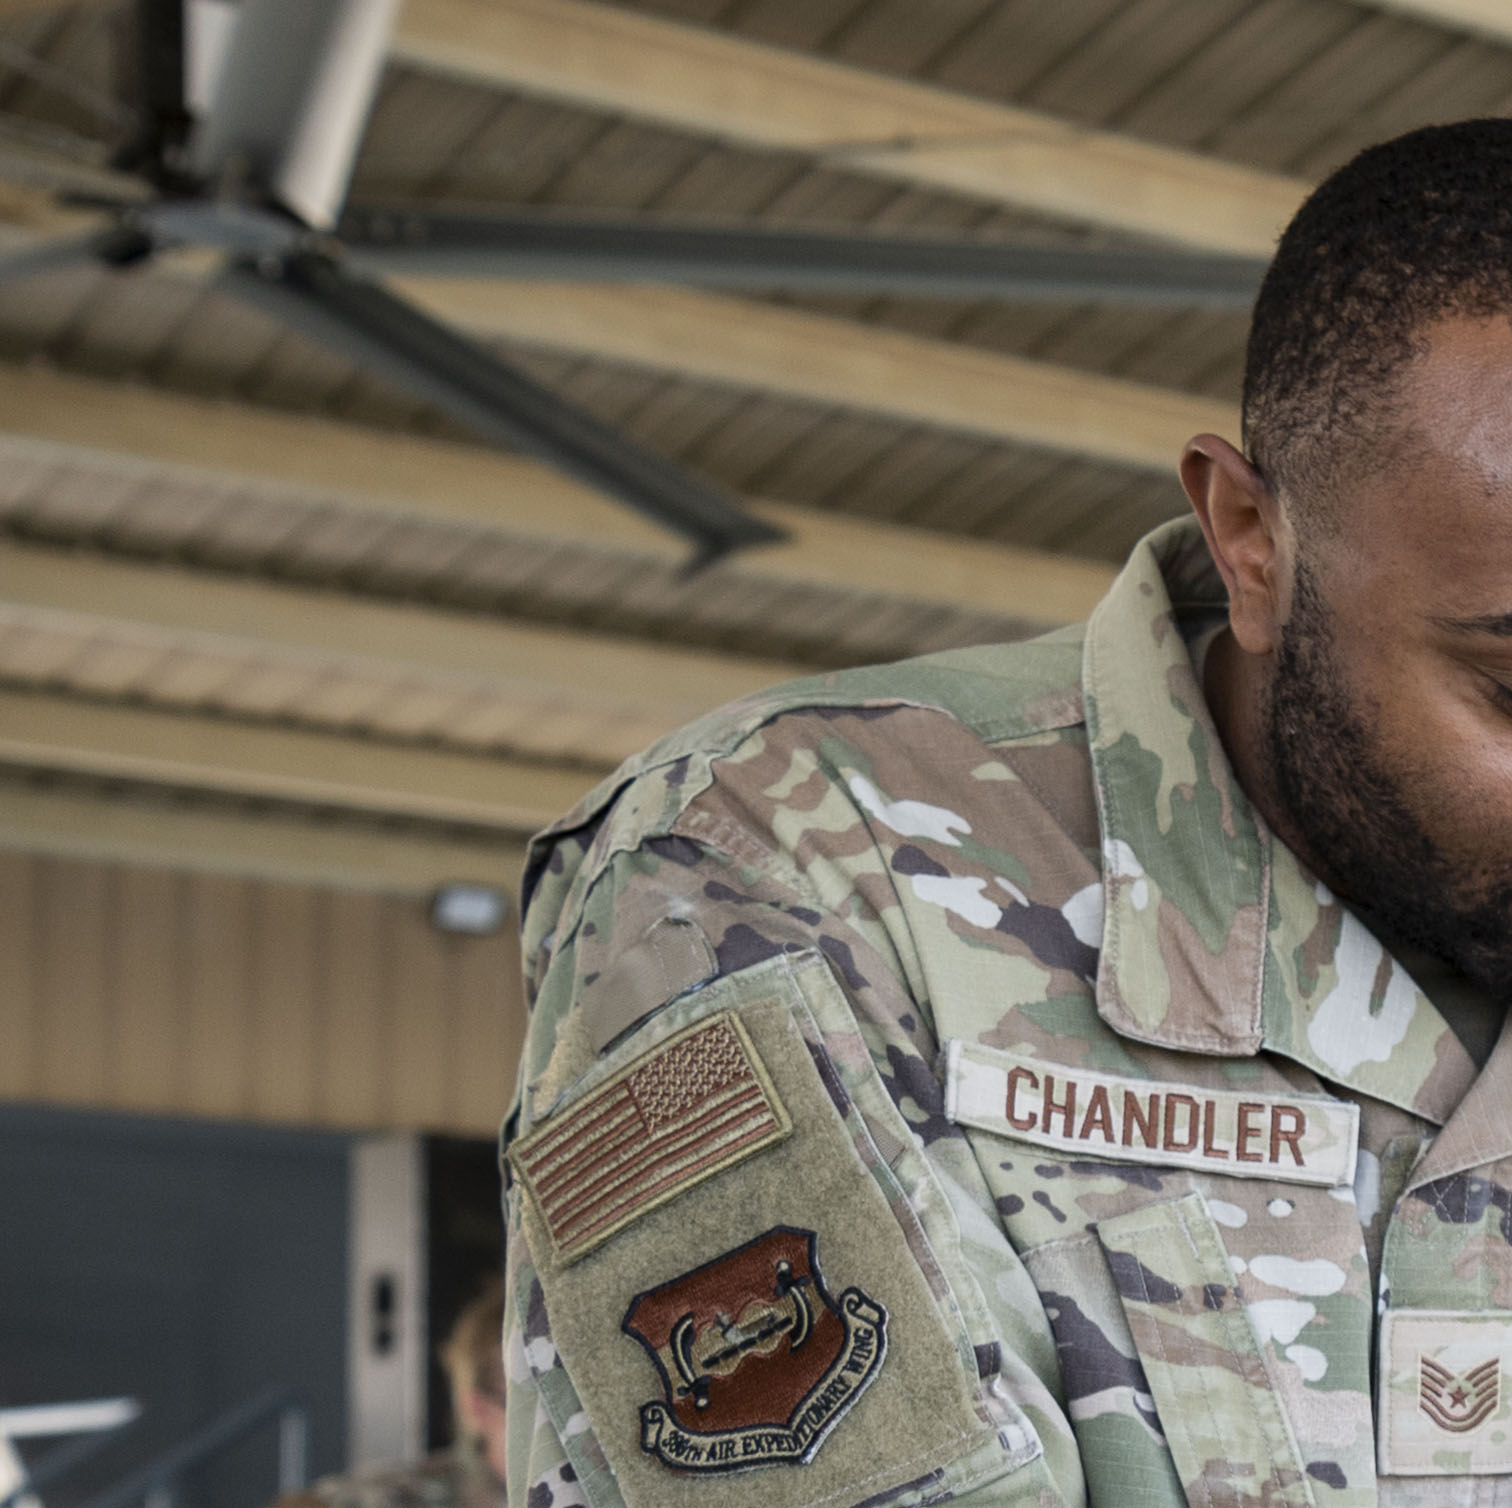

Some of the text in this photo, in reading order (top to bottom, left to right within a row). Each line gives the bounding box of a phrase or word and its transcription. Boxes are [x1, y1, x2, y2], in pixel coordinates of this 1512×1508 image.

[1005, 1065, 1306, 1167] CHANDLER
[705, 1440, 739, 1462] AIR
[741, 1374, 852, 1457] EXPEDITIONARY
[843, 1326, 874, 1375] WING
